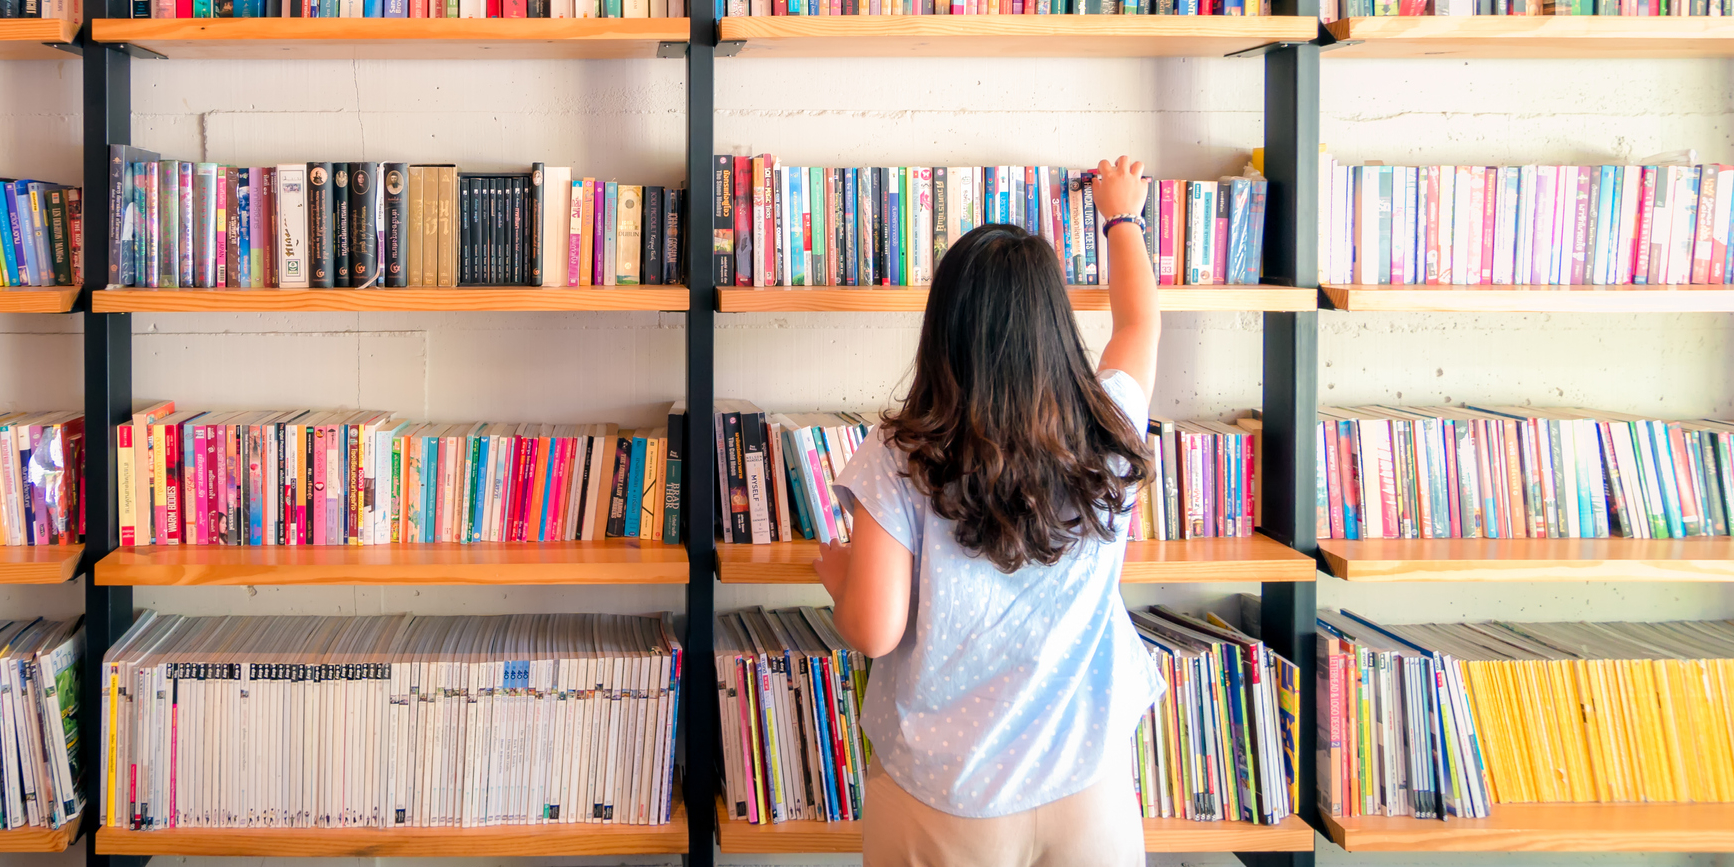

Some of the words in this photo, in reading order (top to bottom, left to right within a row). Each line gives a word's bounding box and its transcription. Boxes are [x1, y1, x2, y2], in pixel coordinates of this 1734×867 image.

[1084, 182, 1093, 208] FINANCIAL
[667, 212, 678, 227] JOHN
[1085, 210, 1093, 225] LIVES
[667, 238, 677, 263] GRISHAM
[1086, 232, 1094, 250] POETS
[167, 486, 176, 510] BODIES
[751, 475, 759, 502] MYSELF
[168, 512, 176, 532] WARM
[1330, 657, 1339, 692] LETTERHEAD
[1331, 699, 1339, 714] LOGO
[1331, 717, 1340, 740] DESIGNS
